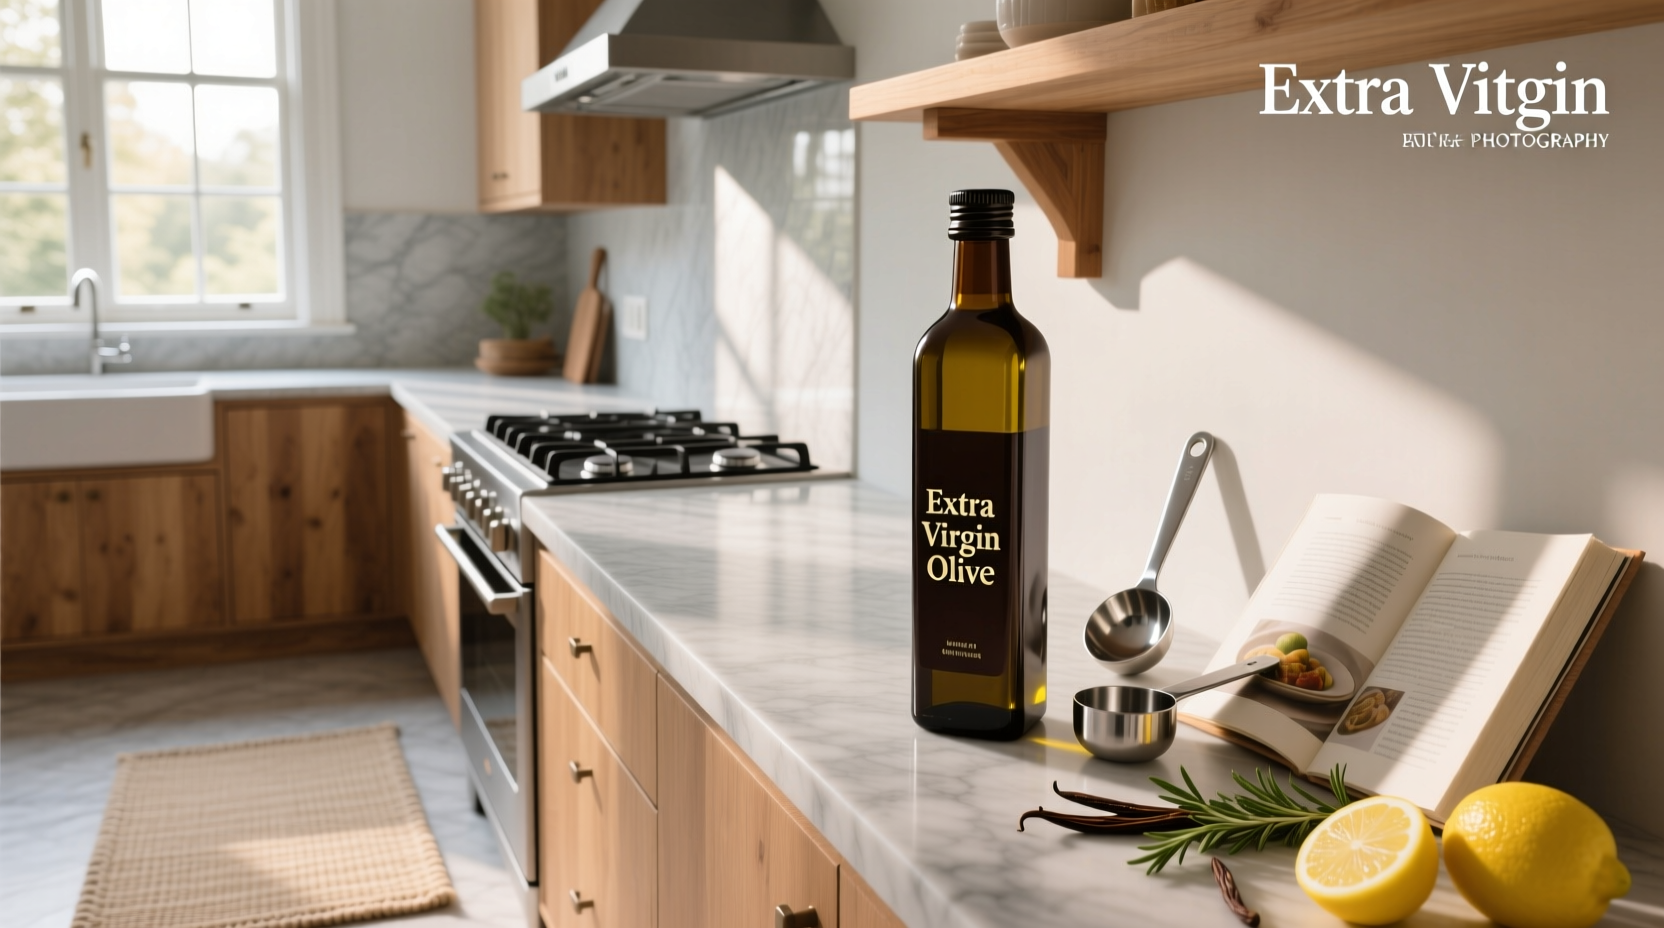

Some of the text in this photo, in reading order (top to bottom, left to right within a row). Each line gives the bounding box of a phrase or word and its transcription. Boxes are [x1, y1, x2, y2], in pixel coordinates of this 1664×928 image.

[926, 488, 996, 518] Extra
[921, 520, 1001, 558] Virgin
[926, 554, 996, 586] Olive
